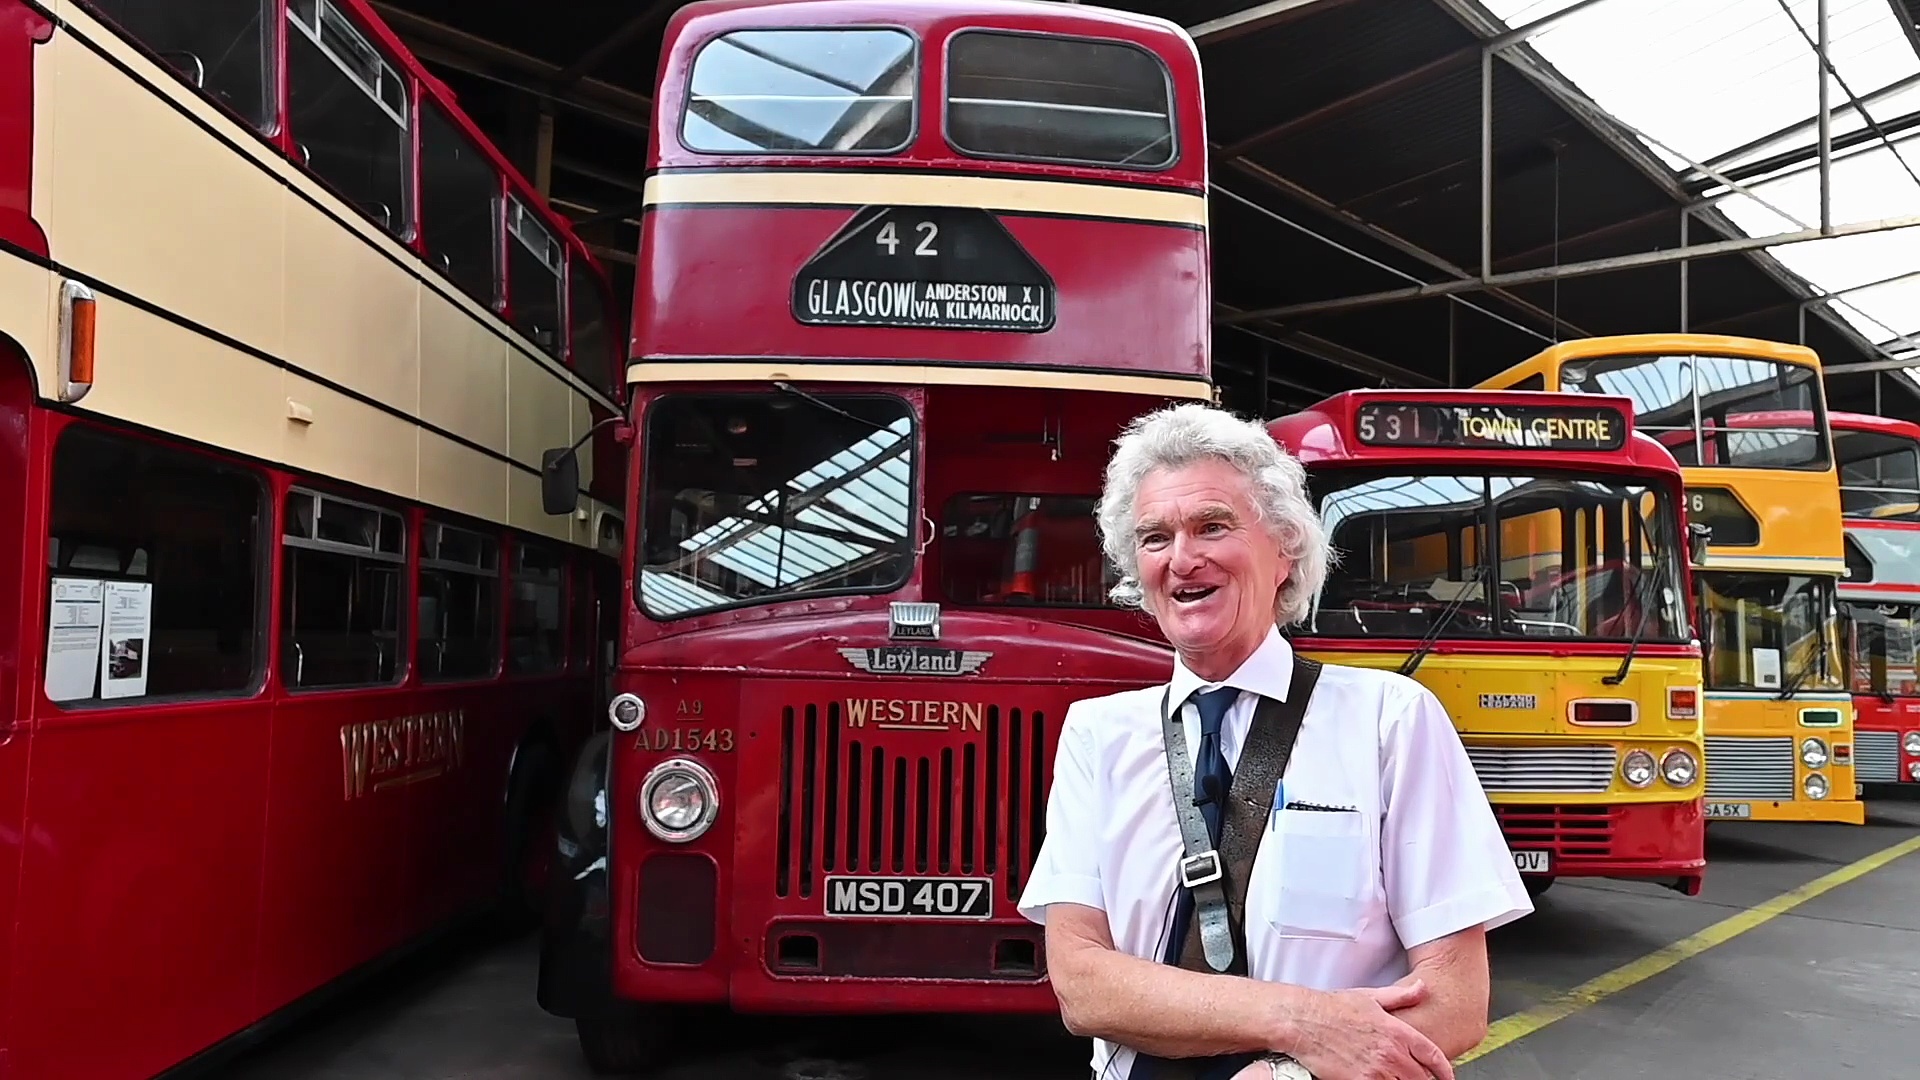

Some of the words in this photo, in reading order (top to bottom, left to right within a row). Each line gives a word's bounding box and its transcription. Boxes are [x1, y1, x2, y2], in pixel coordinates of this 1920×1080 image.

[876, 221, 938, 256] 42
[808, 279, 912, 317] GLASGOW
[925, 283, 1007, 302] ANDERSTON
[1022, 286, 1031, 303] X
[915, 303, 939, 319] VIA
[946, 303, 1040, 322] KILMARNOCK
[1460, 416, 1523, 439] TOWN
[1532, 418, 1610, 441] CENTRE
[896, 627, 931, 636] LEYLAND
[871, 649, 957, 673] Leyland
[1481, 694, 1533, 702] LEYLAND
[846, 698, 983, 732] WESTERN
[634, 728, 733, 753] AD1543
[340, 708, 464, 801] WESTERN
[835, 880, 904, 913] MSD
[913, 881, 982, 914] 407
